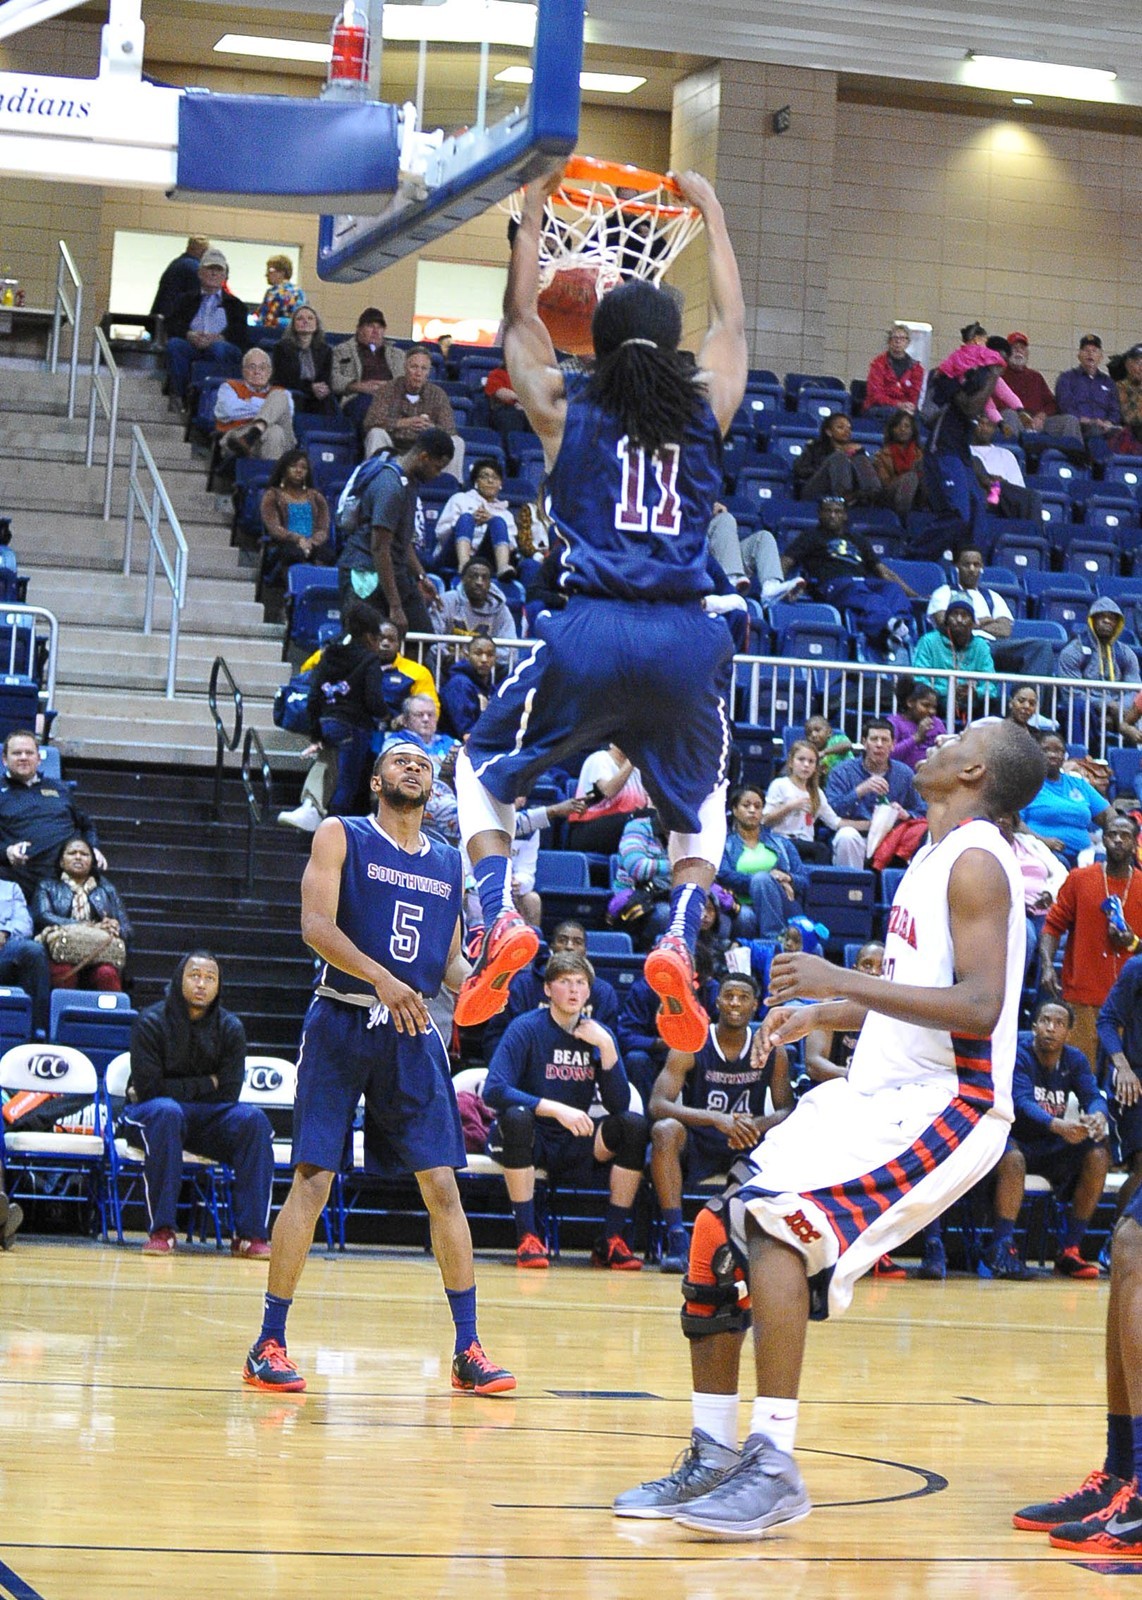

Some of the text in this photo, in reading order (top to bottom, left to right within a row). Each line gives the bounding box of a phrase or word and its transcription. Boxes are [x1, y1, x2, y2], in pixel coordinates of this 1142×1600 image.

[615, 434, 682, 536] 11
[367, 862, 452, 900] SOUTHWEST
[389, 900, 424, 963] 5
[29, 1055, 68, 1078] ICC
[553, 1048, 590, 1067] BEAR
